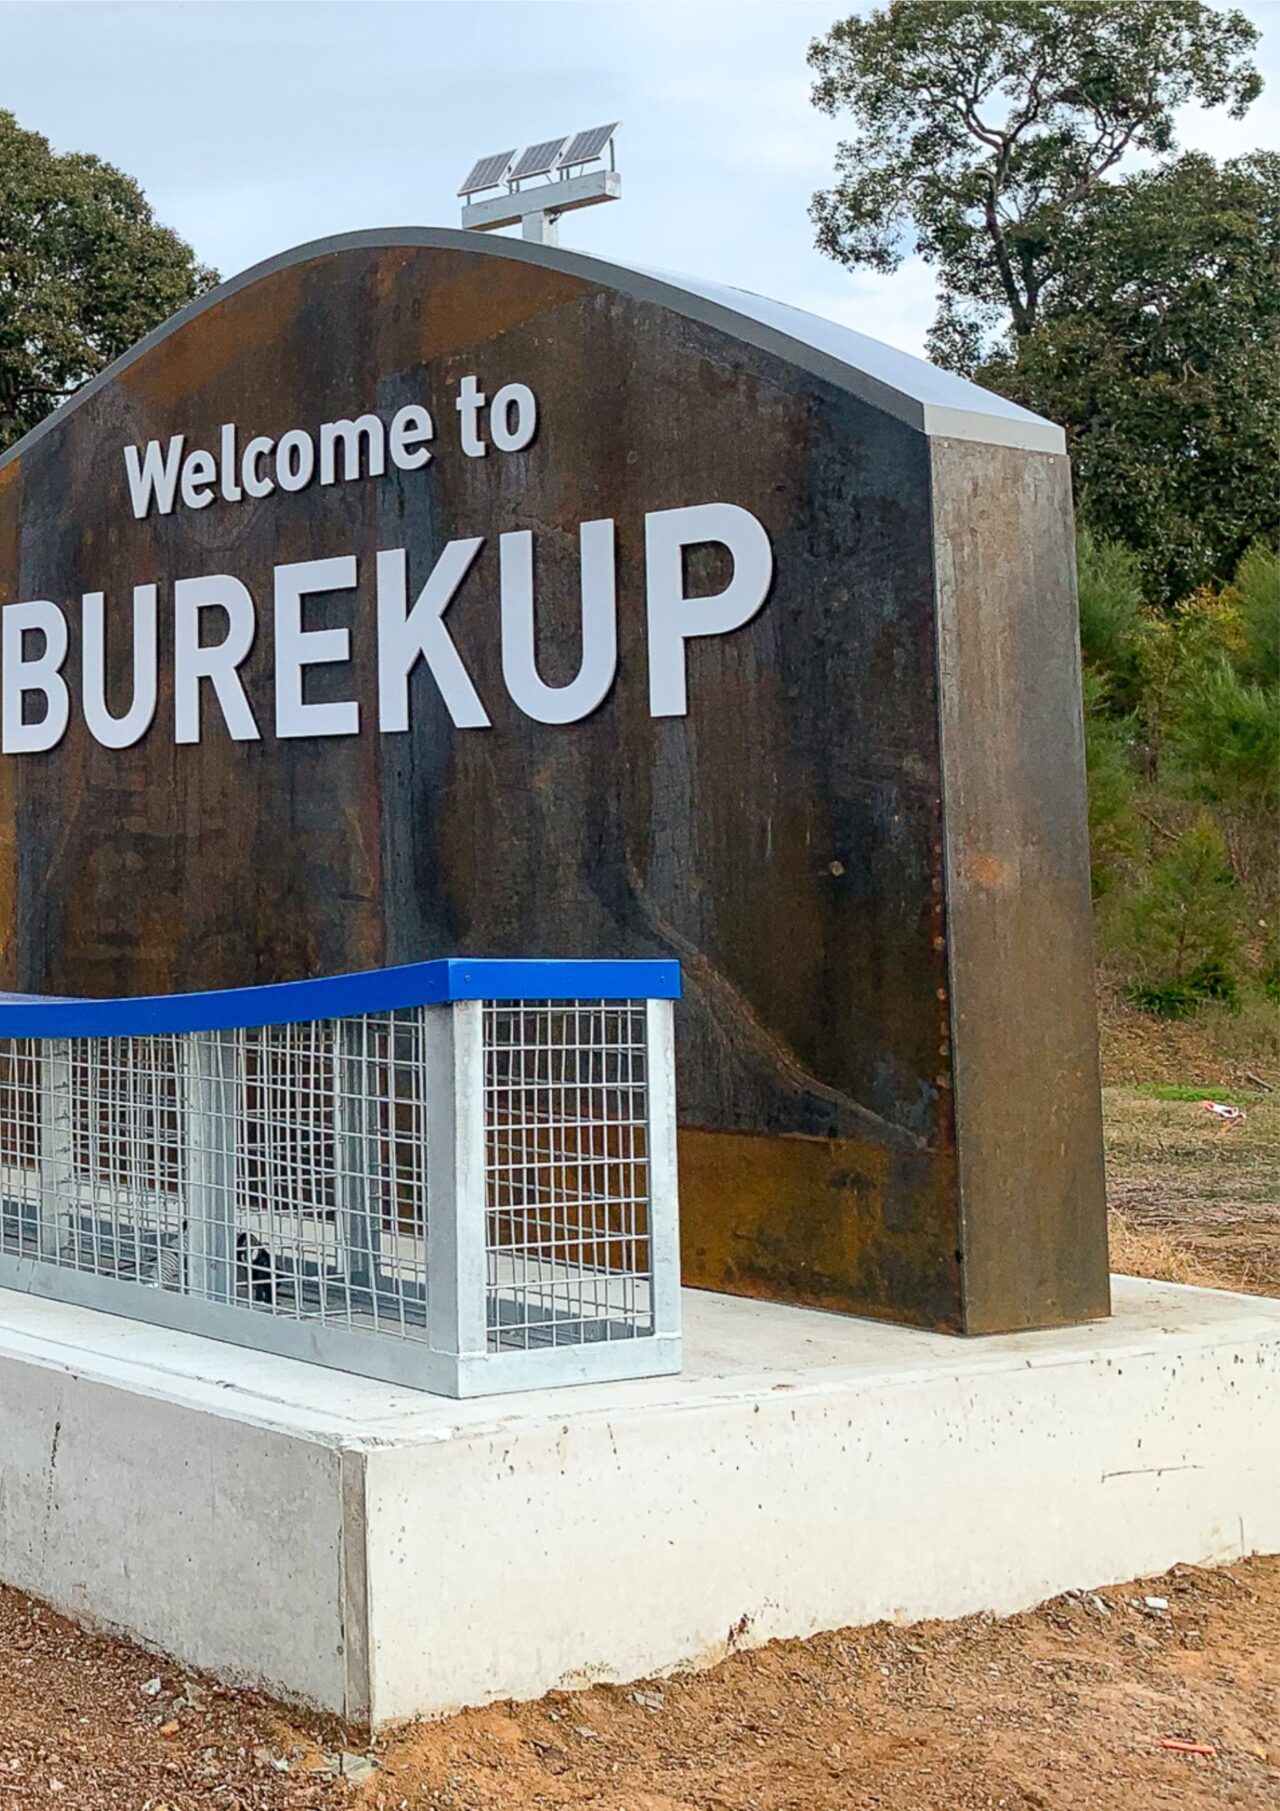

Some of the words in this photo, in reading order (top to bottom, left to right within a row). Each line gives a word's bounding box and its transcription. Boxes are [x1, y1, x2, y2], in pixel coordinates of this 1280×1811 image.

[123, 404, 435, 520] Welcome
[455, 374, 537, 458] to
[1, 501, 774, 755] BUREKUP
